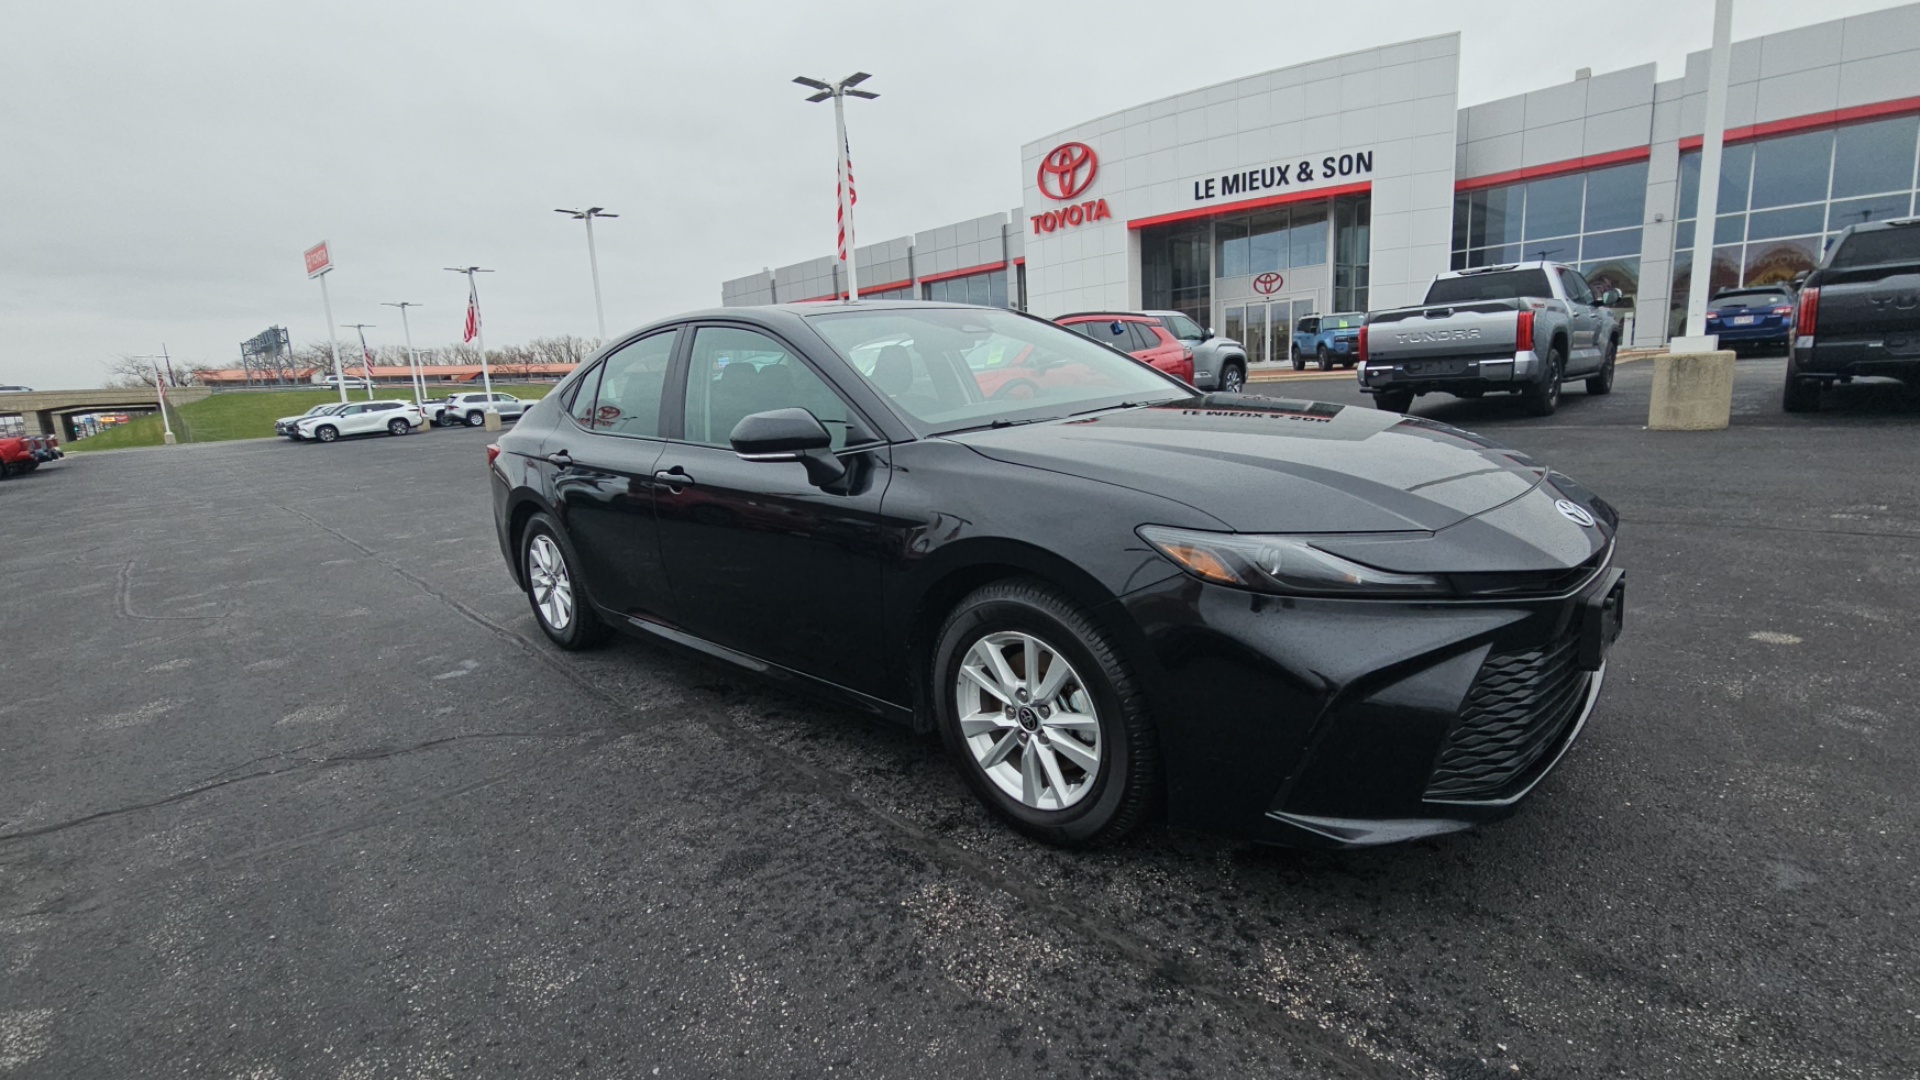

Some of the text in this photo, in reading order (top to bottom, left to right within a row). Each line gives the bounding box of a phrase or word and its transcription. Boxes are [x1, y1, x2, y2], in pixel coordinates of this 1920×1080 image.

[1194, 150, 1373, 201] LE MIEUX & SON
[1030, 198, 1111, 235] TOYOTA
[1395, 328, 1481, 344] TUNDRA
